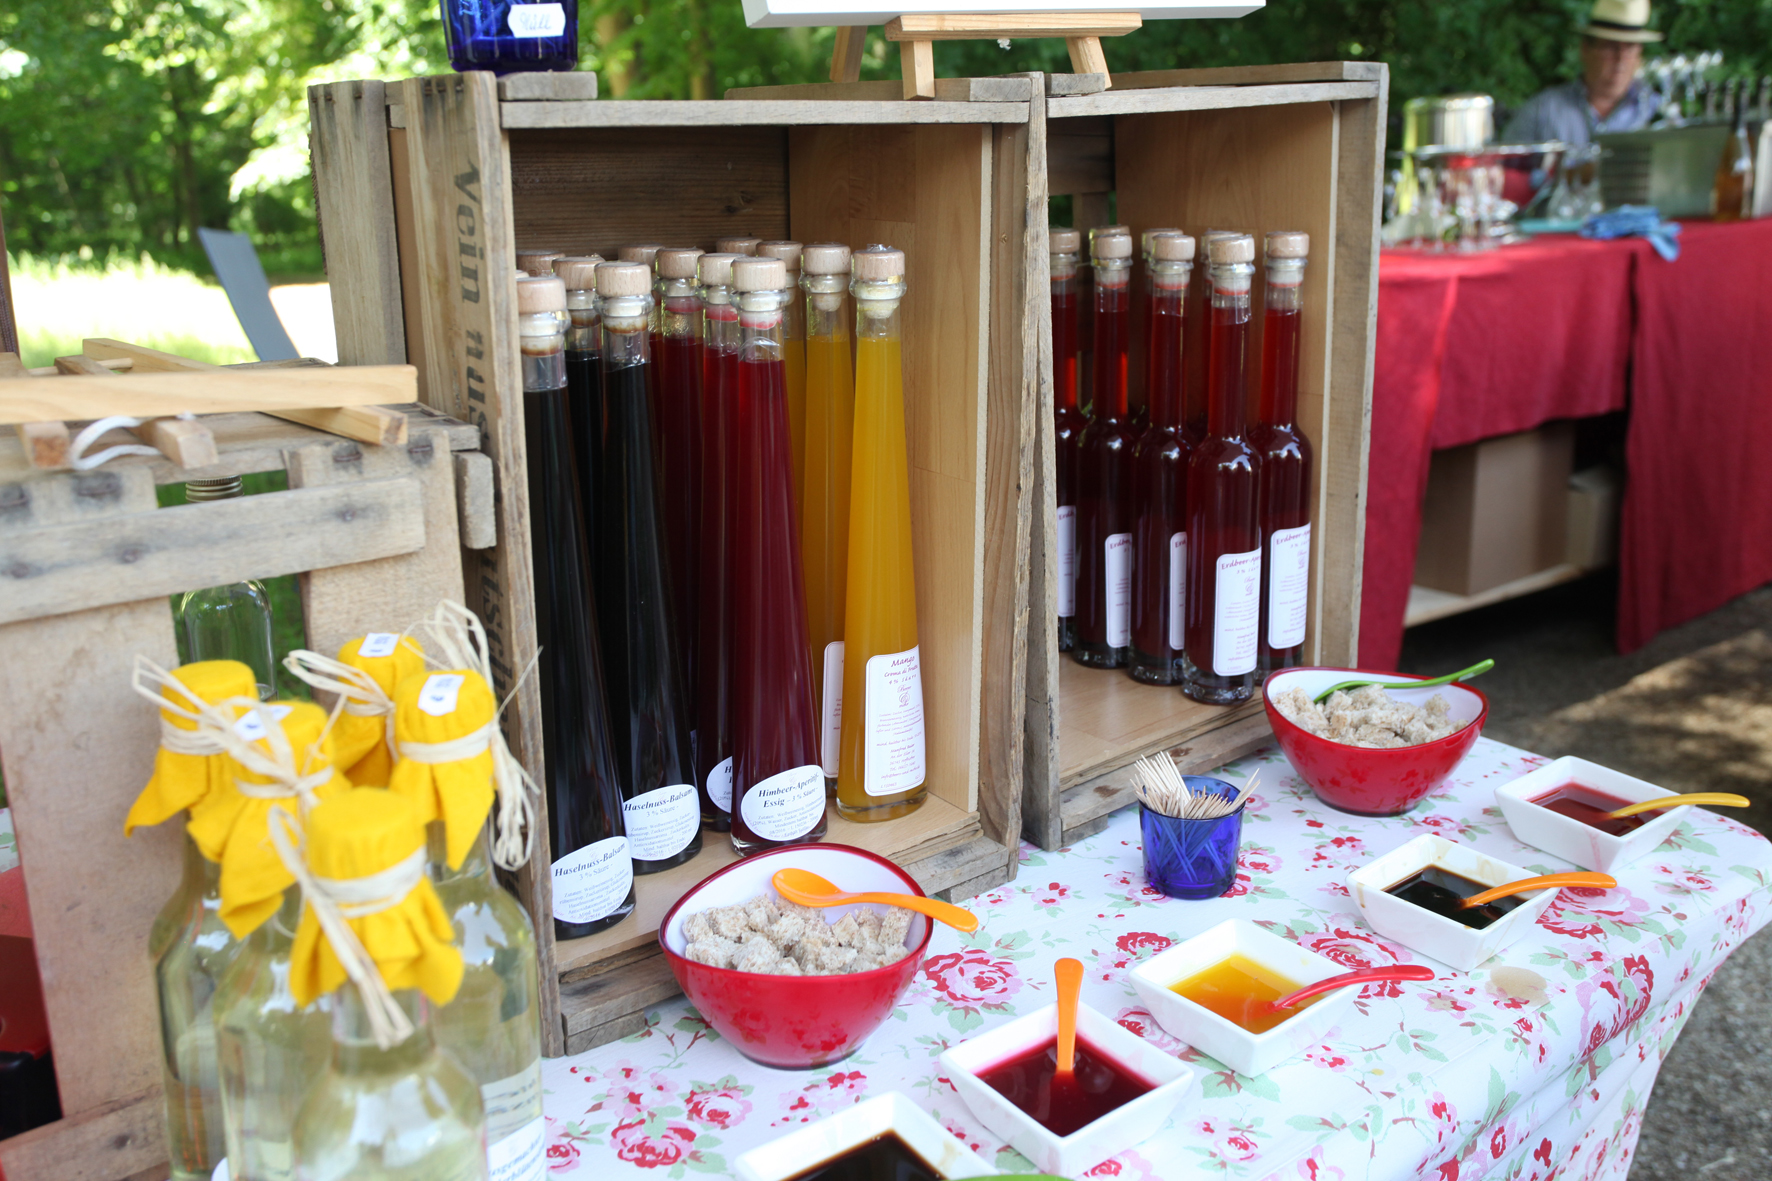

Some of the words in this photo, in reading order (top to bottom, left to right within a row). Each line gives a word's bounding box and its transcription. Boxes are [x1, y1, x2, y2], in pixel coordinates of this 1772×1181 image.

[890, 655, 915, 668] Mango
[624, 788, 693, 812] Haselnuss-Balsam
[763, 798, 786, 808] Essig
[554, 842, 626, 877] Haselnuss-Balsam
